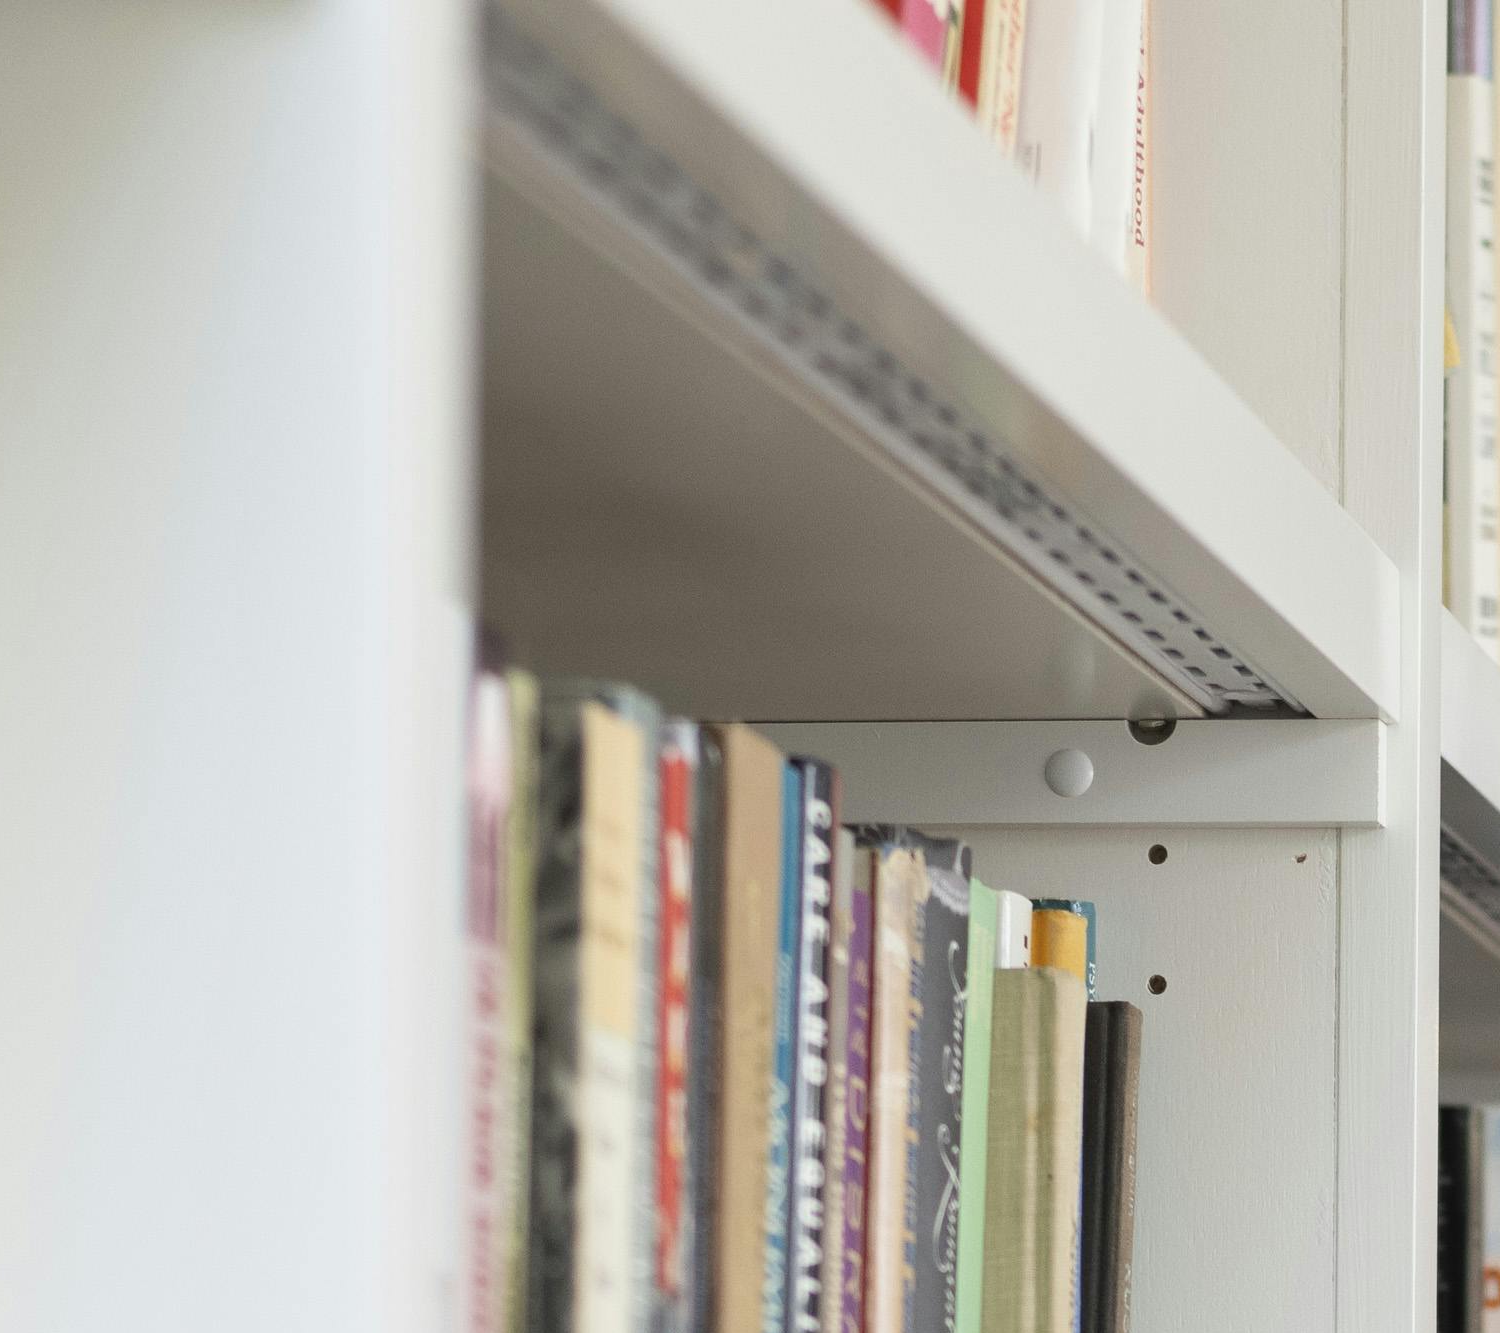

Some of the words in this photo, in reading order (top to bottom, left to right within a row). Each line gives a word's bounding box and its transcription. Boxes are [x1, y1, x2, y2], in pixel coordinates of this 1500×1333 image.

[1134, 71, 1145, 247] Adulthood
[805, 798, 833, 946] CARE
[802, 973, 830, 1086] AND
